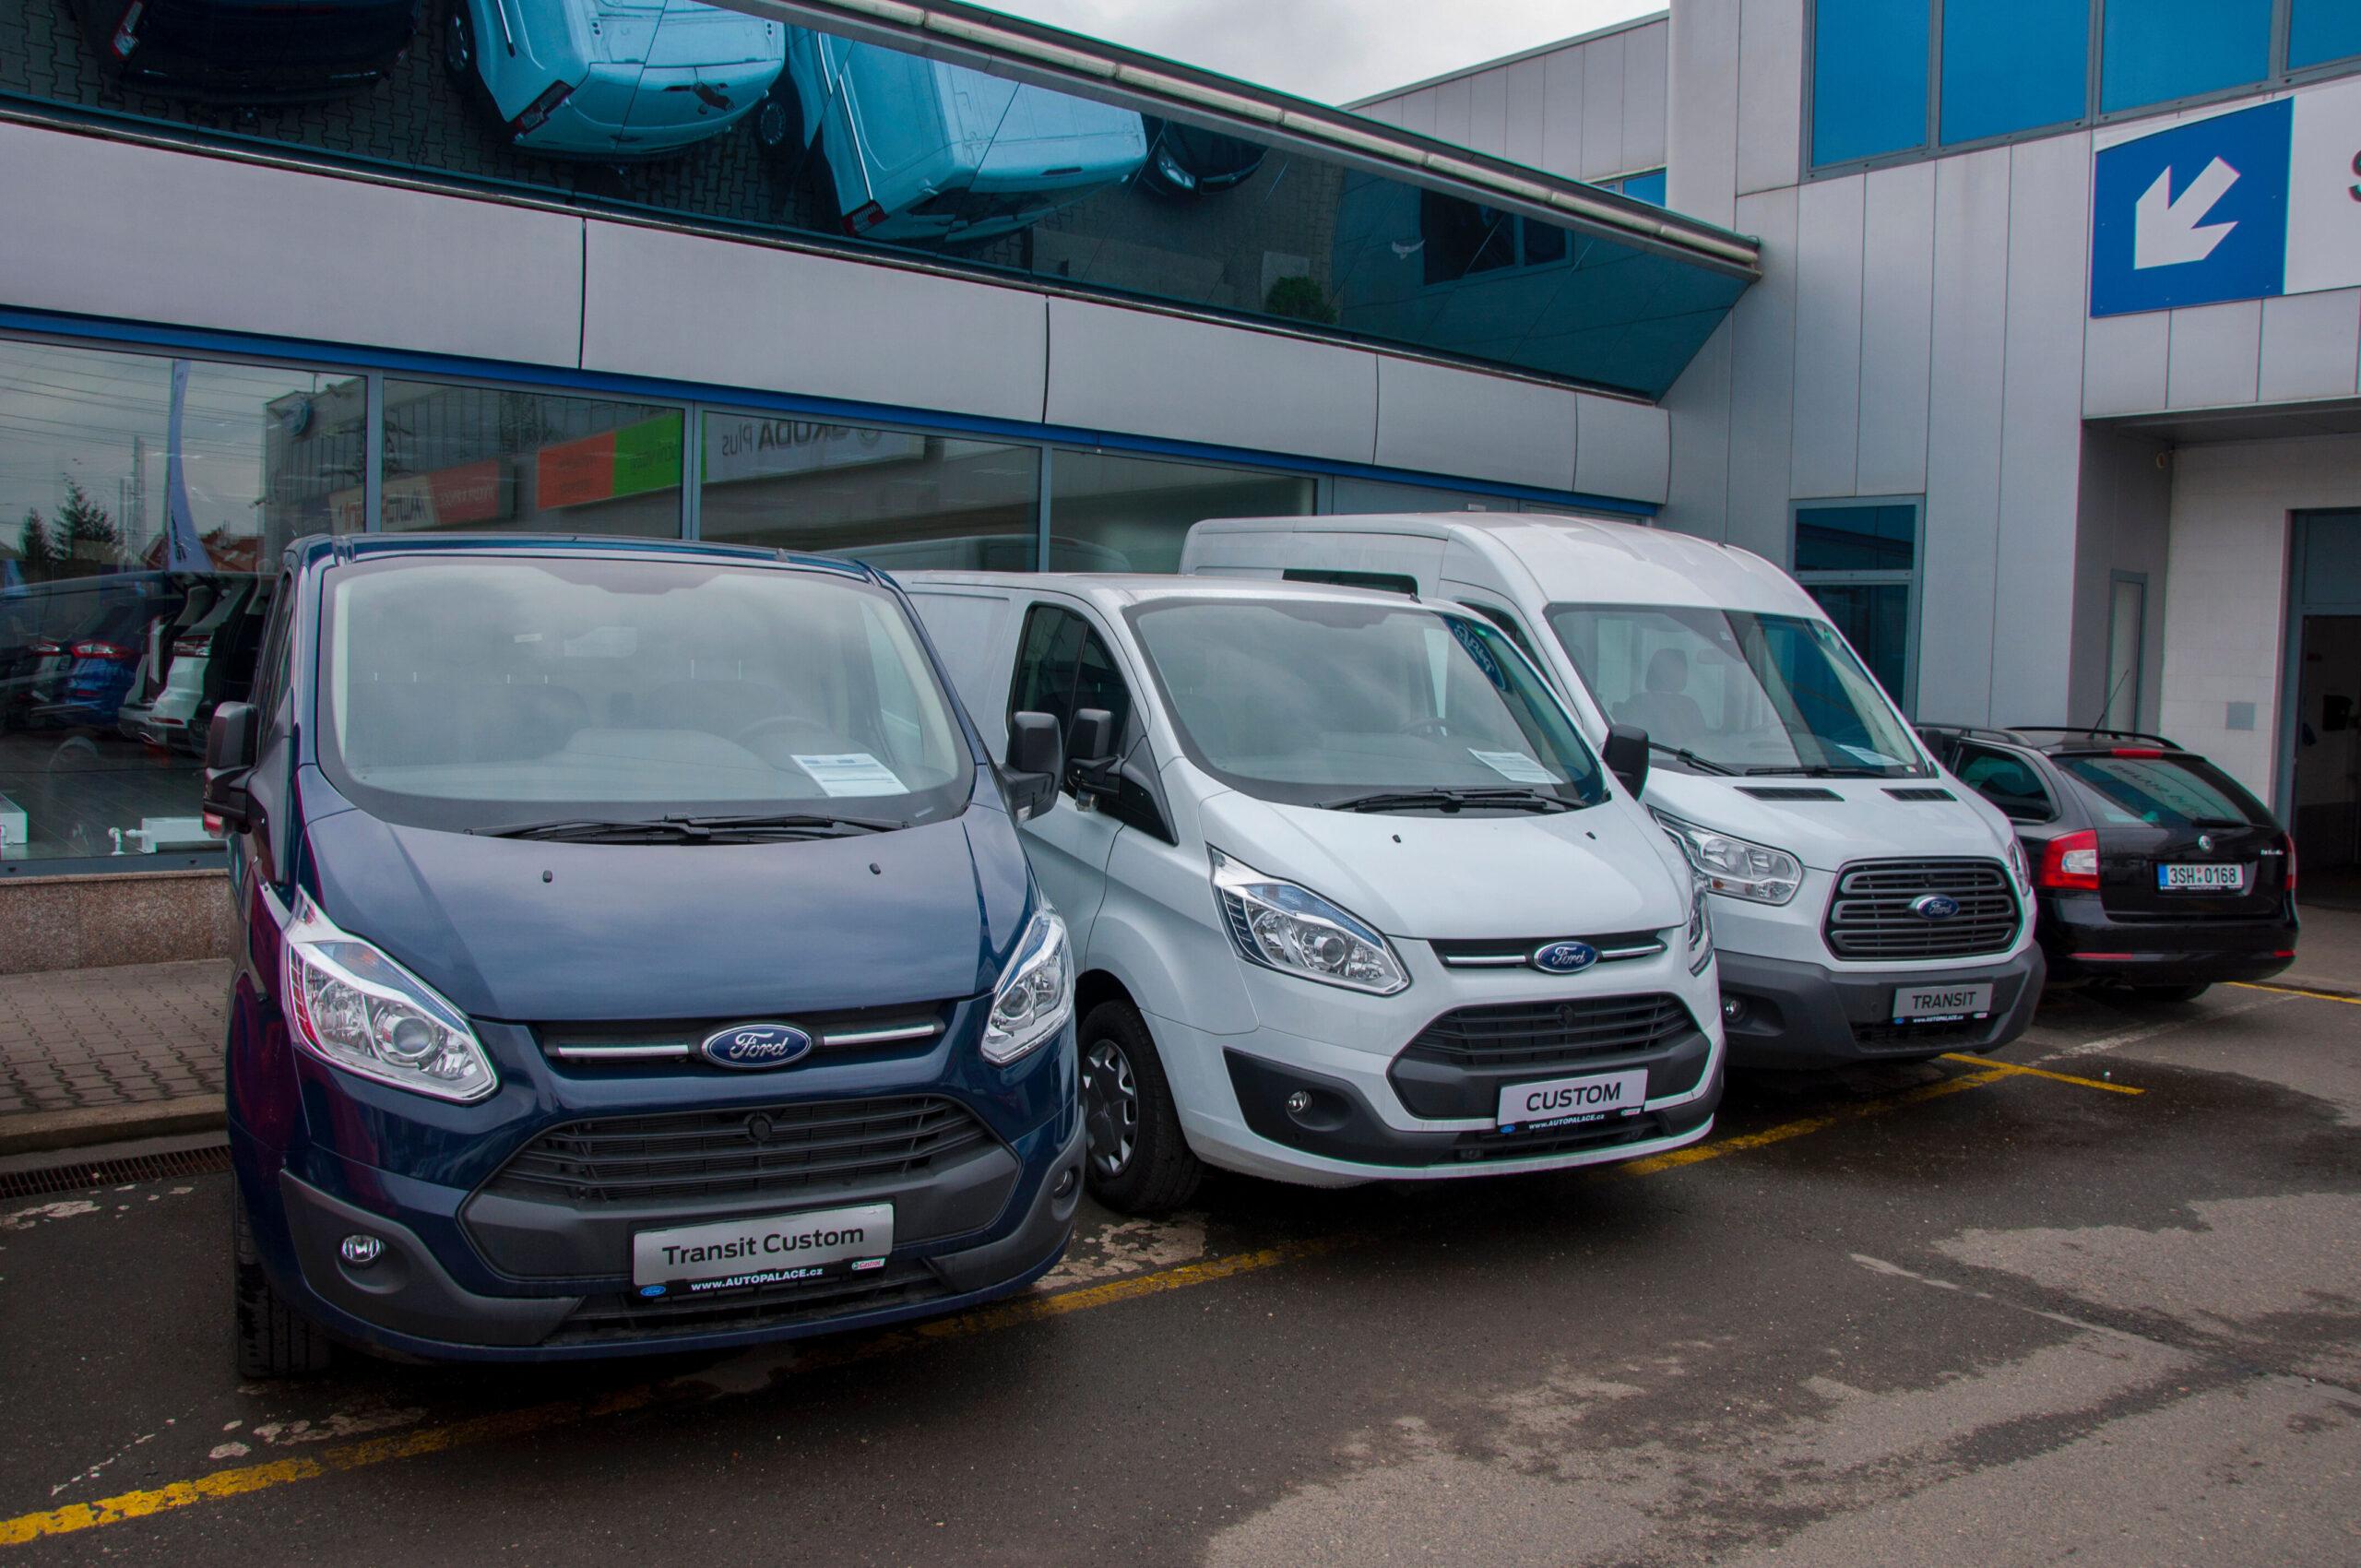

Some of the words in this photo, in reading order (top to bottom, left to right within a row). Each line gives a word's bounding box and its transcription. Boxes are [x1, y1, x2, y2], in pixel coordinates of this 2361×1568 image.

[2170, 867, 2195, 884] 3SH
[2204, 866, 2236, 884] 0168
[1928, 901, 1952, 915] Ford
[1551, 946, 1585, 966] Ford
[1913, 992, 1976, 1010] TRANSIT
[729, 1031, 789, 1059] Ford
[1526, 1082, 1621, 1112] CUSTOM
[1528, 1113, 1605, 1130] www.AUTOPALACE.cz
[661, 1236, 757, 1265] Transit
[763, 1227, 864, 1254] Custom
[691, 1267, 824, 1291] www.AUTOPALACE.cz
